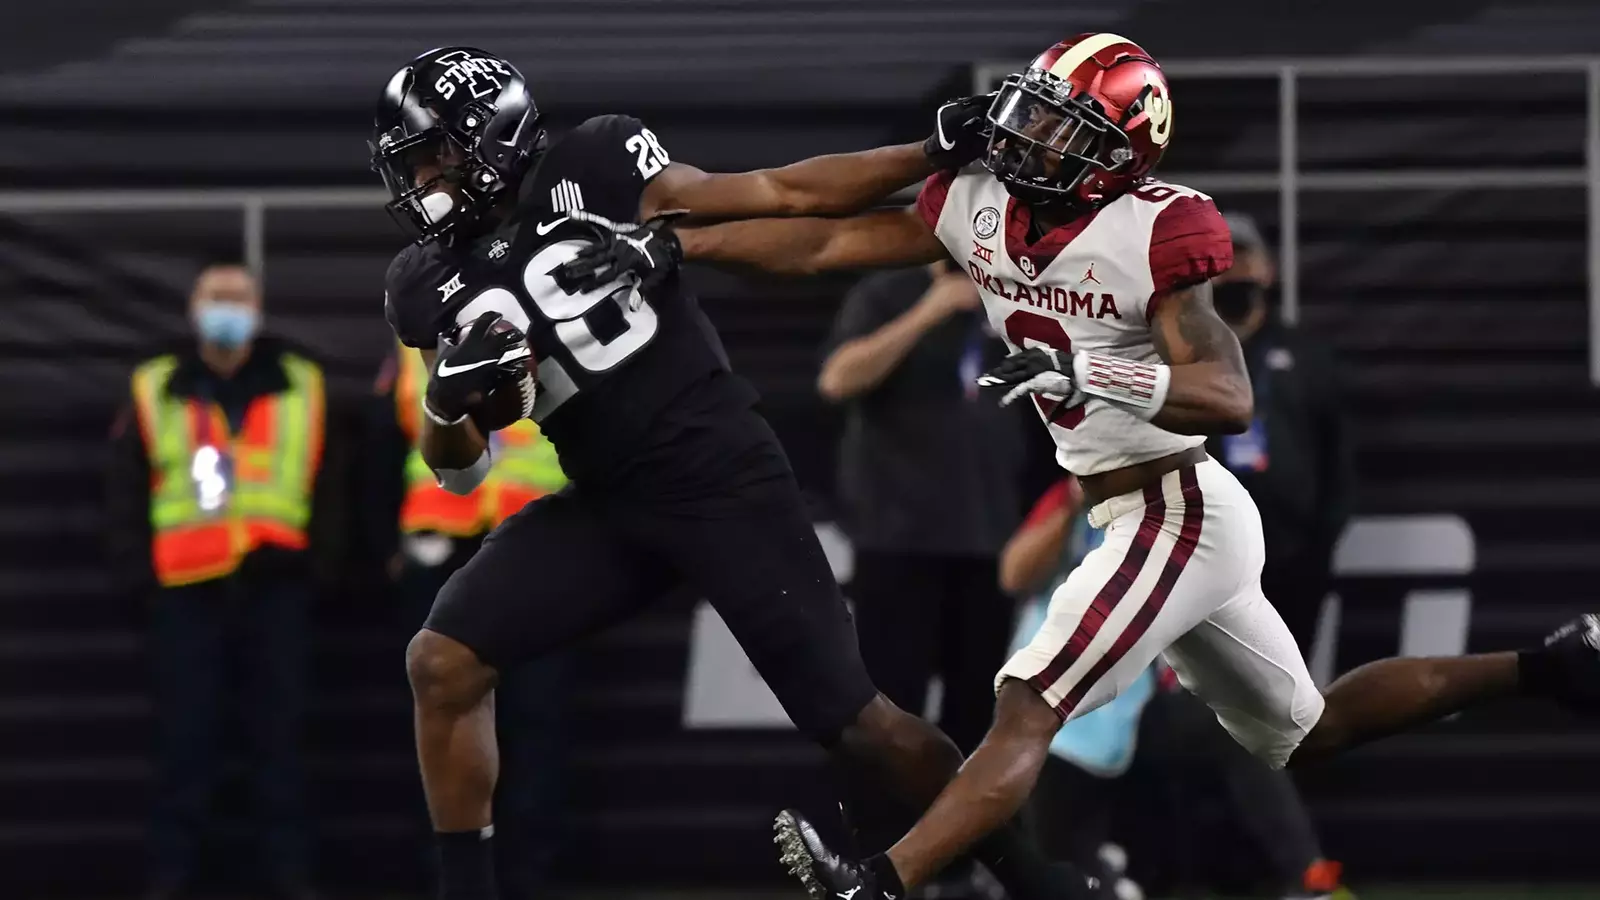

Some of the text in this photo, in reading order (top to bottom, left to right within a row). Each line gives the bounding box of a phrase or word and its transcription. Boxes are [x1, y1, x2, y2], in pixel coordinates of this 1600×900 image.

[435, 57, 511, 100] STATE
[625, 128, 670, 180] 28
[973, 240, 994, 265] XII
[1020, 256, 1036, 277] OU
[437, 272, 466, 303] XII
[968, 260, 1122, 319] OKLAHOMA
